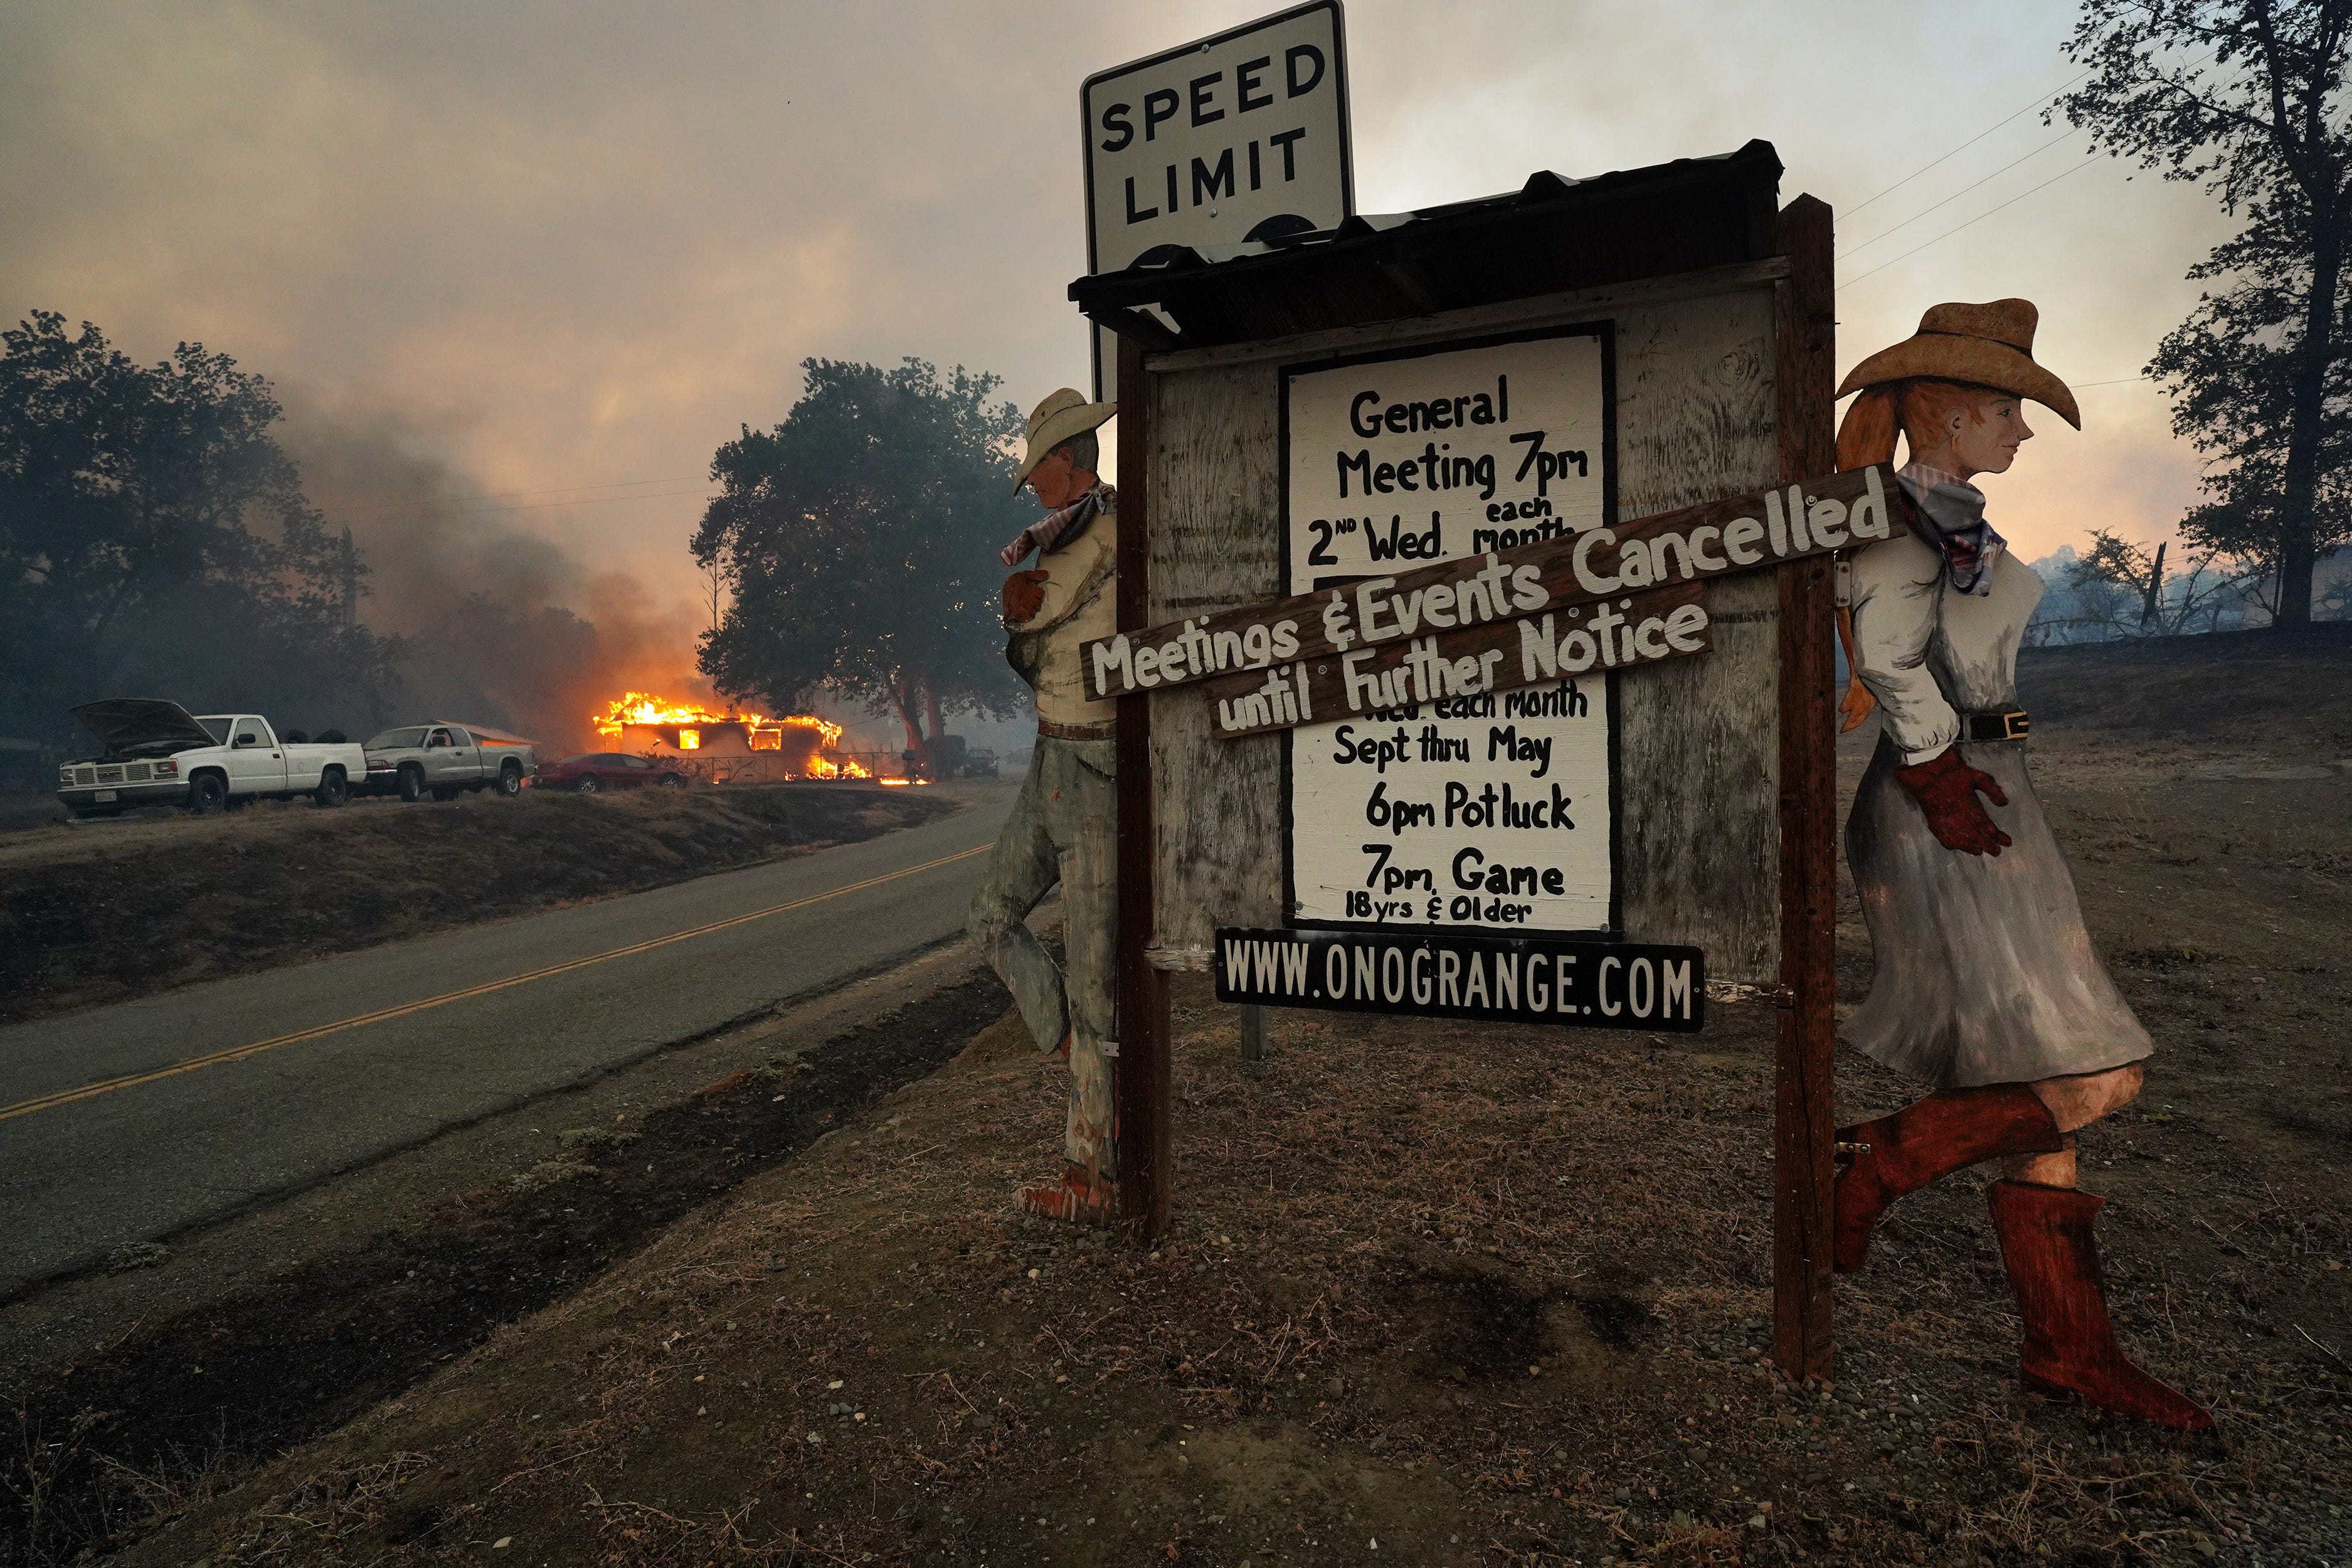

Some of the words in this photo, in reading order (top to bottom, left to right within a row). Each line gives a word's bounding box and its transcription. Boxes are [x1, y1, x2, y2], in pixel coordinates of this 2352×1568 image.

[1101, 44, 1325, 152] SPEED
[1125, 127, 1306, 225] LIMIT
[1350, 374, 1508, 438] General
[1337, 442, 1496, 501] Meeting
[1510, 430, 1588, 497] 7pm
[1364, 511, 1448, 561] Wed.
[1486, 497, 1552, 522] each
[1092, 616, 1301, 696] Meetings
[1322, 590, 1356, 652] &
[1356, 553, 1550, 643] Events
[1572, 465, 1890, 595] Cancelled
[1218, 661, 1313, 731] until
[1342, 634, 1504, 711] Further
[1517, 598, 1711, 682] Notice
[1434, 693, 1496, 719] each
[1505, 679, 1588, 719] month
[1333, 724, 1411, 774] Sept
[1416, 724, 1470, 763] thru
[1488, 725, 1552, 778] May
[1366, 781, 1436, 836] 6pm
[1452, 847, 1565, 896] Game
[1449, 896, 1532, 923] Older
[1224, 938, 1692, 1020] WWW.ONOGRANGE.COM
